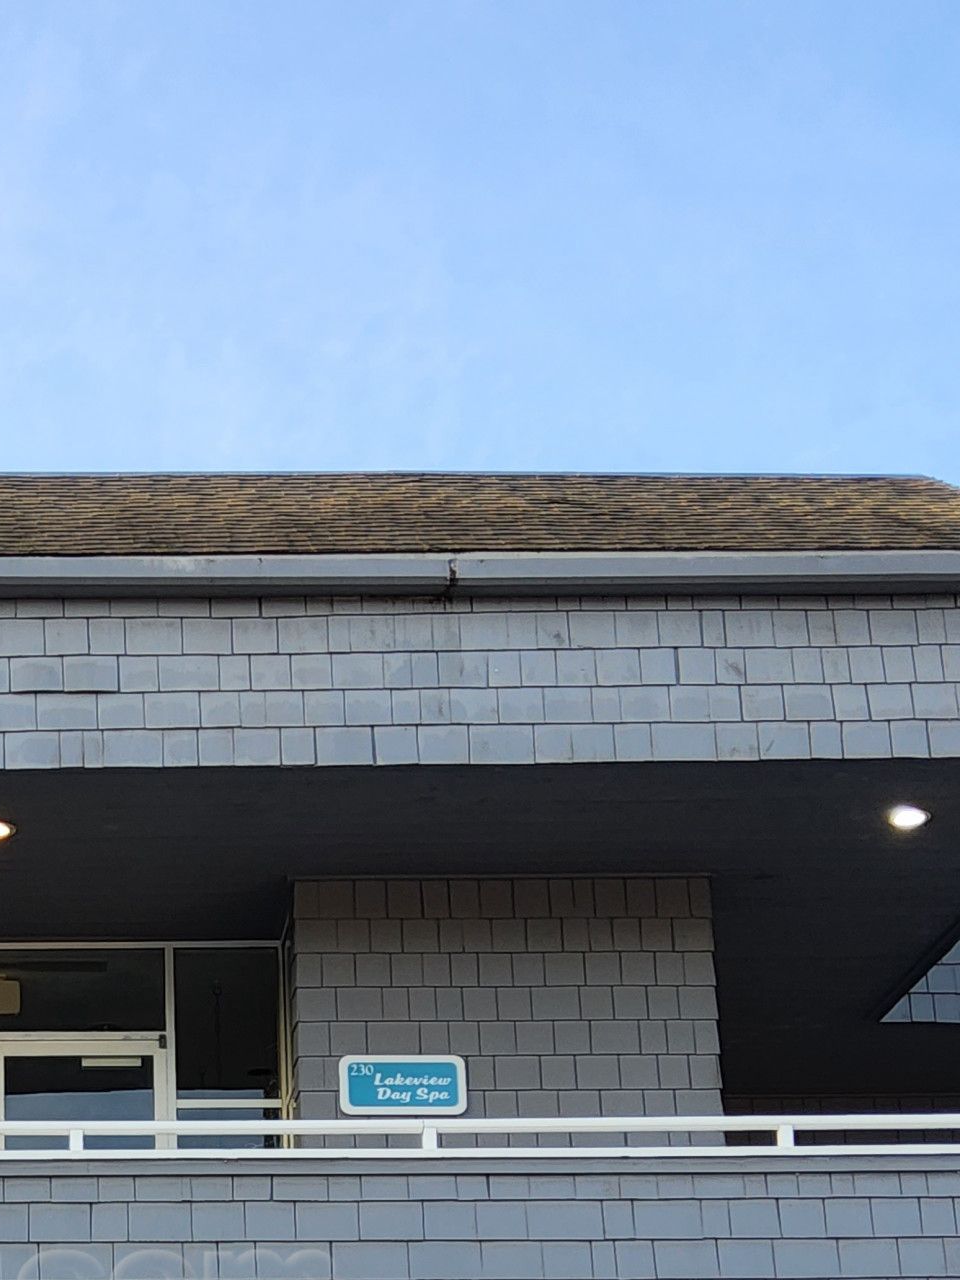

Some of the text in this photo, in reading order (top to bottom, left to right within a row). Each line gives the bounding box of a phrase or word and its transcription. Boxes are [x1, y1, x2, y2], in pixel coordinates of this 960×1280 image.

[350, 1064, 375, 1076] 230
[374, 1073, 452, 1086] Lakeview
[377, 1087, 451, 1103] Day Spa
